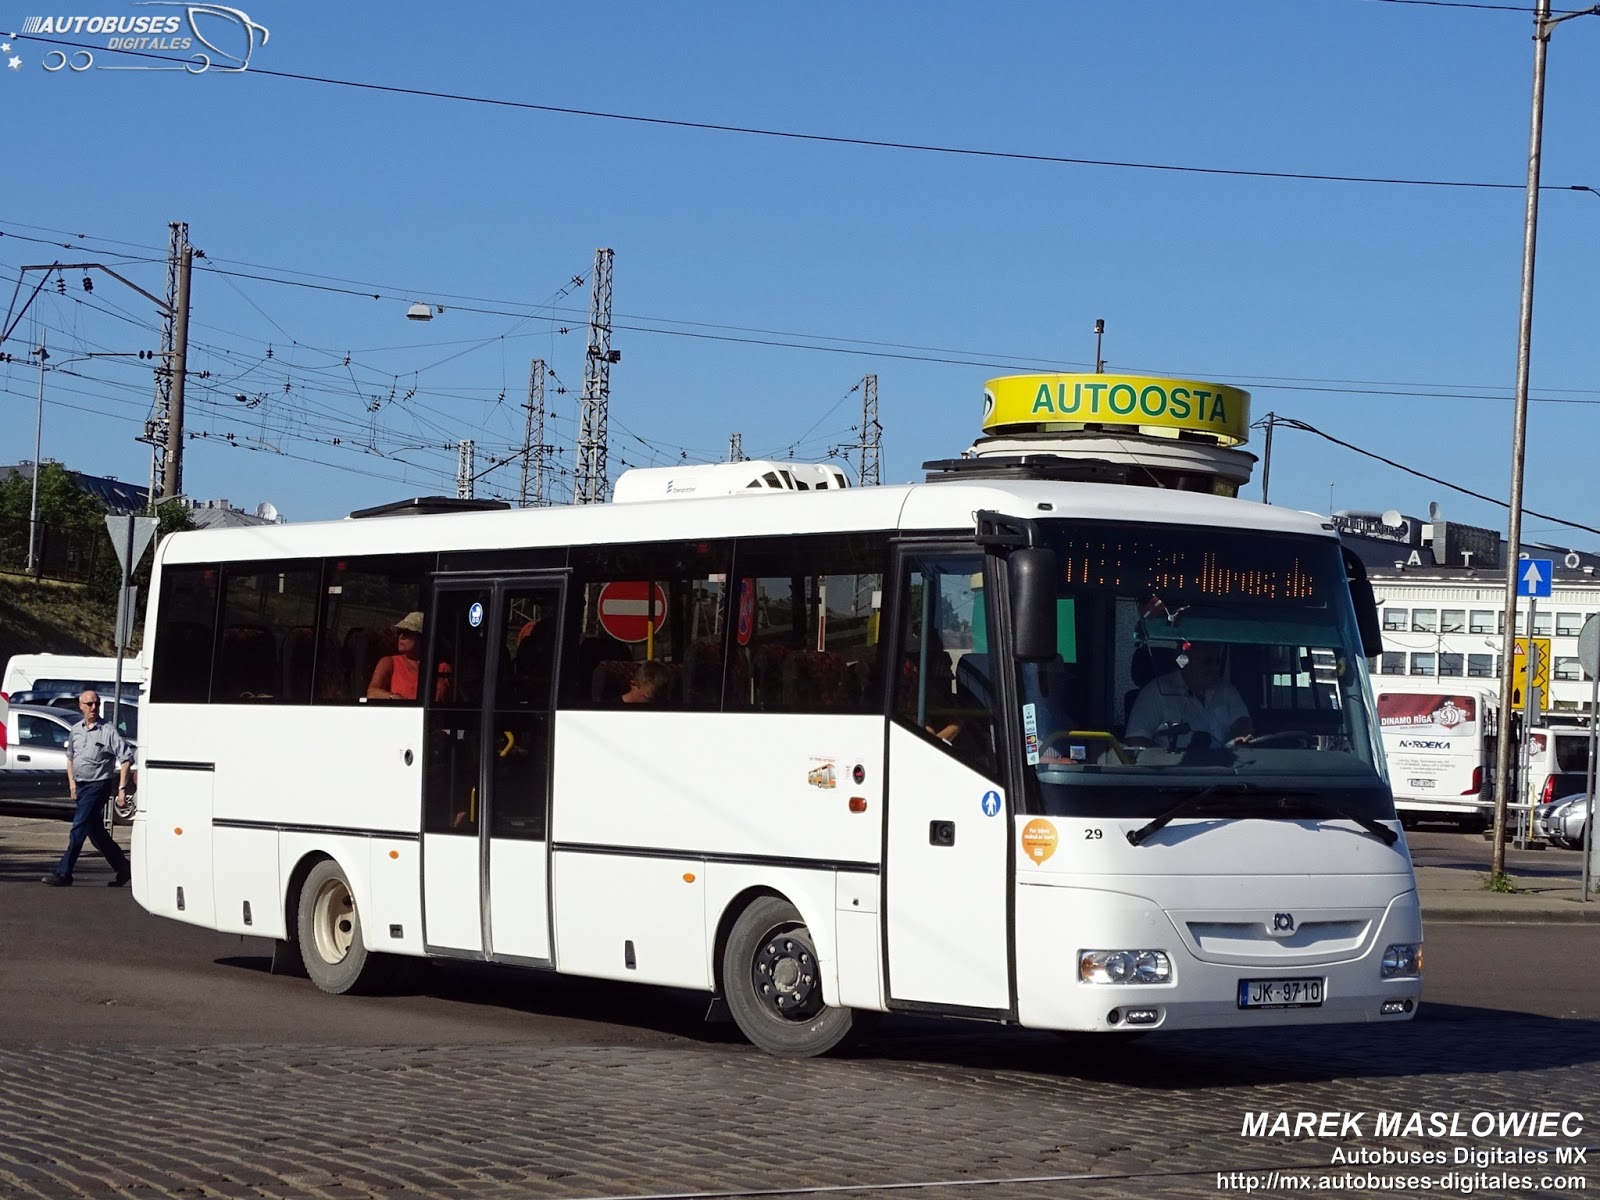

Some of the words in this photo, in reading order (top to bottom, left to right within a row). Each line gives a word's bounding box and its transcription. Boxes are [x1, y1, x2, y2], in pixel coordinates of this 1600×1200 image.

[1031, 382, 1227, 424] AUTOOSTA
[1381, 716, 1412, 726] DINAMO
[1413, 714, 1433, 724] RĪGA
[1399, 740, 1451, 749] NORDEKA
[1084, 829, 1103, 840] 29
[1252, 983, 1319, 1002] JK-9710
